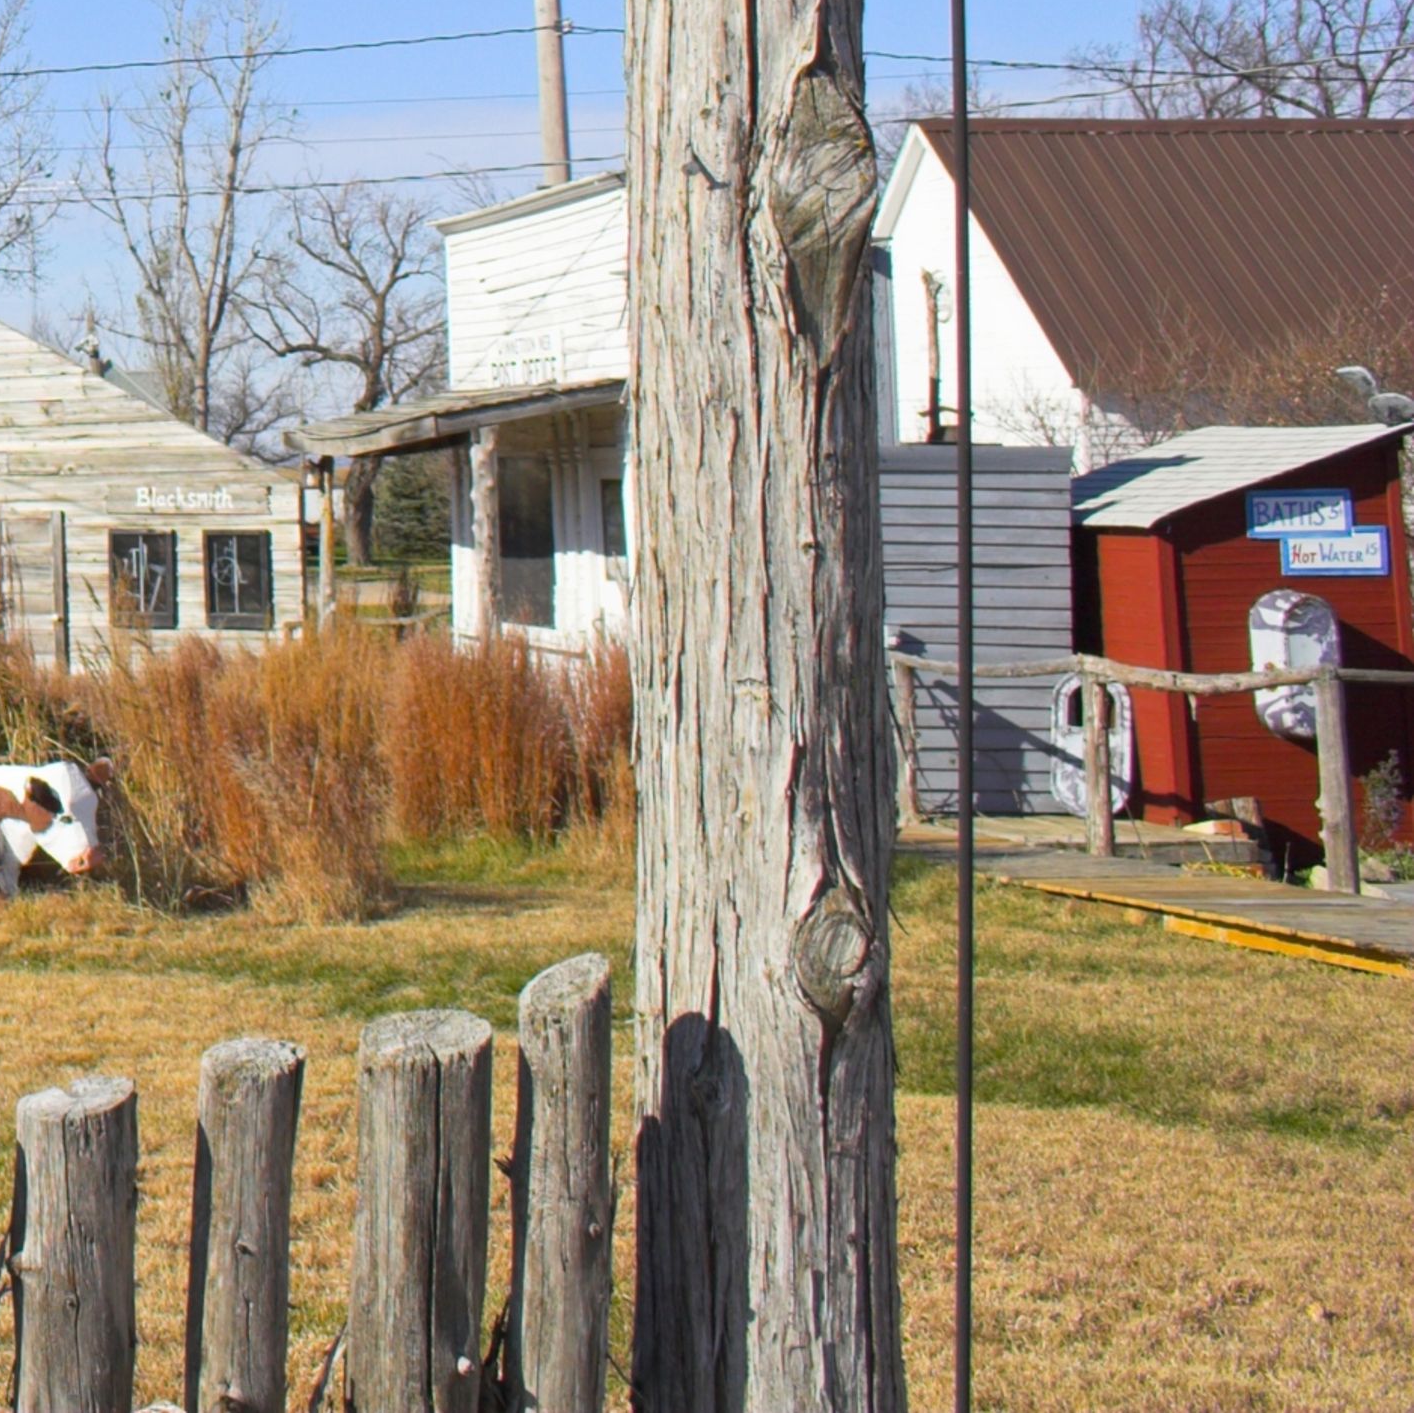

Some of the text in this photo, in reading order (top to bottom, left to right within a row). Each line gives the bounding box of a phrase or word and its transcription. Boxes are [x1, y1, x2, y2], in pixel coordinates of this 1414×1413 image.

[135, 485, 233, 510] Blacksmith
[1255, 500, 1325, 526] BATHS
[1292, 543, 1318, 565] HOT
[1318, 542, 1364, 563] WATER
